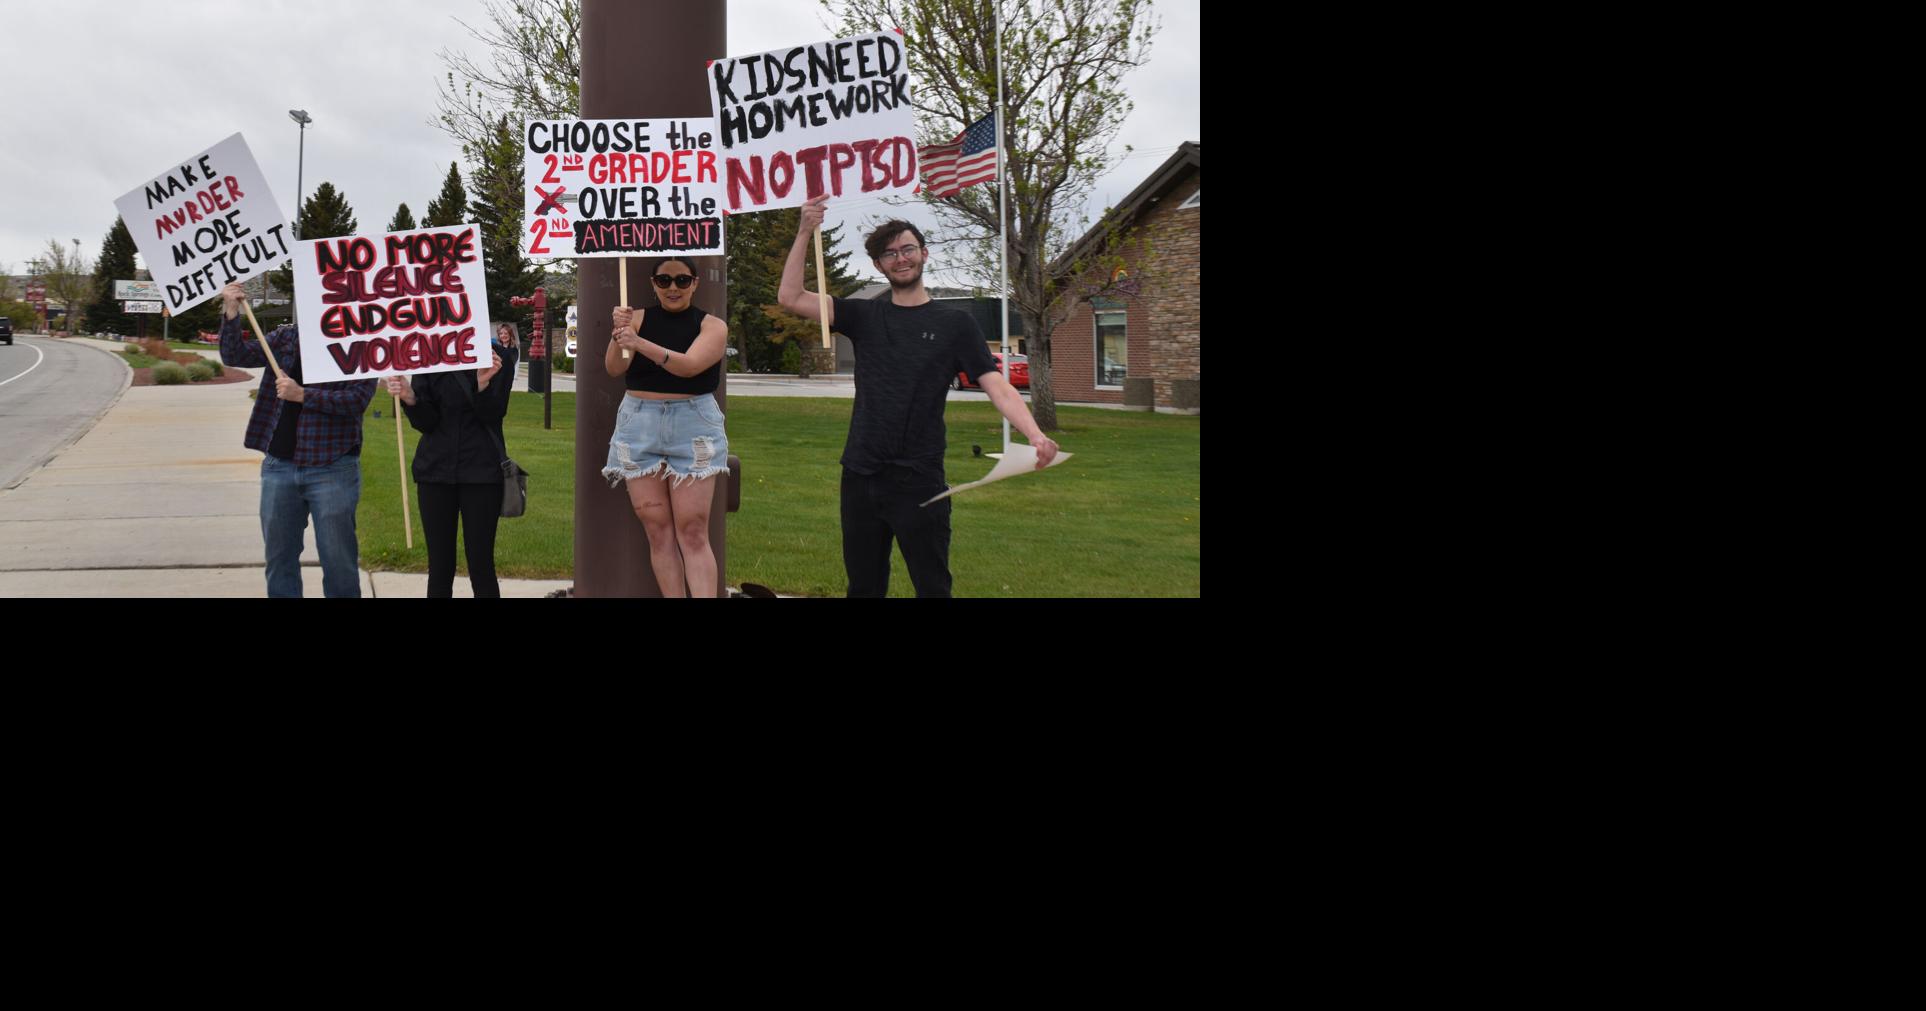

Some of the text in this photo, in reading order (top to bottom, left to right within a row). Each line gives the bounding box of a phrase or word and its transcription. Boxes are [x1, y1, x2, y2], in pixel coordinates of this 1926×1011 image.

[719, 73, 911, 149] HOMEWORK
[528, 121, 712, 153] CHOOSE the
[144, 154, 217, 210] MAKE
[588, 150, 718, 184] GRADER
[155, 175, 245, 240] MURDER
[578, 186, 716, 218] OVER the
[171, 209, 251, 267] MORE
[314, 227, 477, 275] NO MORE
[581, 222, 714, 250] AMENDMENT
[166, 223, 289, 308] DIFFICULT
[321, 263, 465, 304] SILENCE
[326, 327, 478, 375] VIOLENCE
